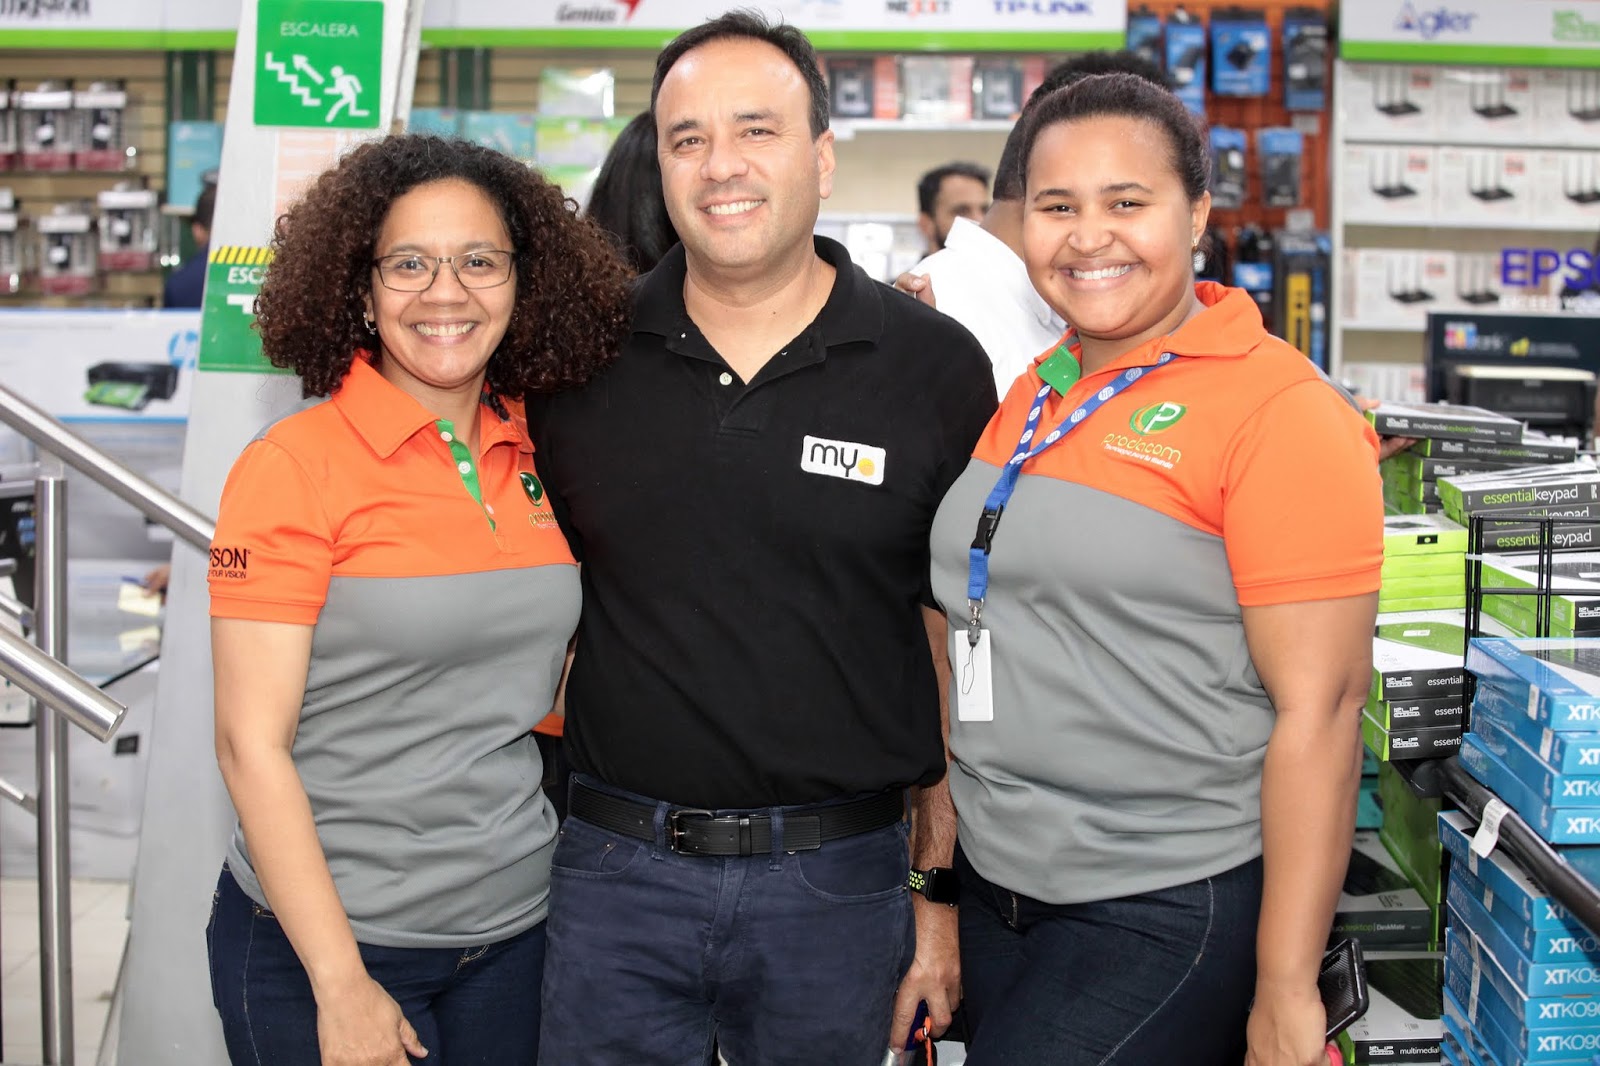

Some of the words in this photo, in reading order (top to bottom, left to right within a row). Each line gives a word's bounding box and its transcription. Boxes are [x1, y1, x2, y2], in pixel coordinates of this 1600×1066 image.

[280, 22, 358, 37] ESCALERA
[228, 266, 265, 285] ESC
[1501, 248, 1600, 289] EPS
